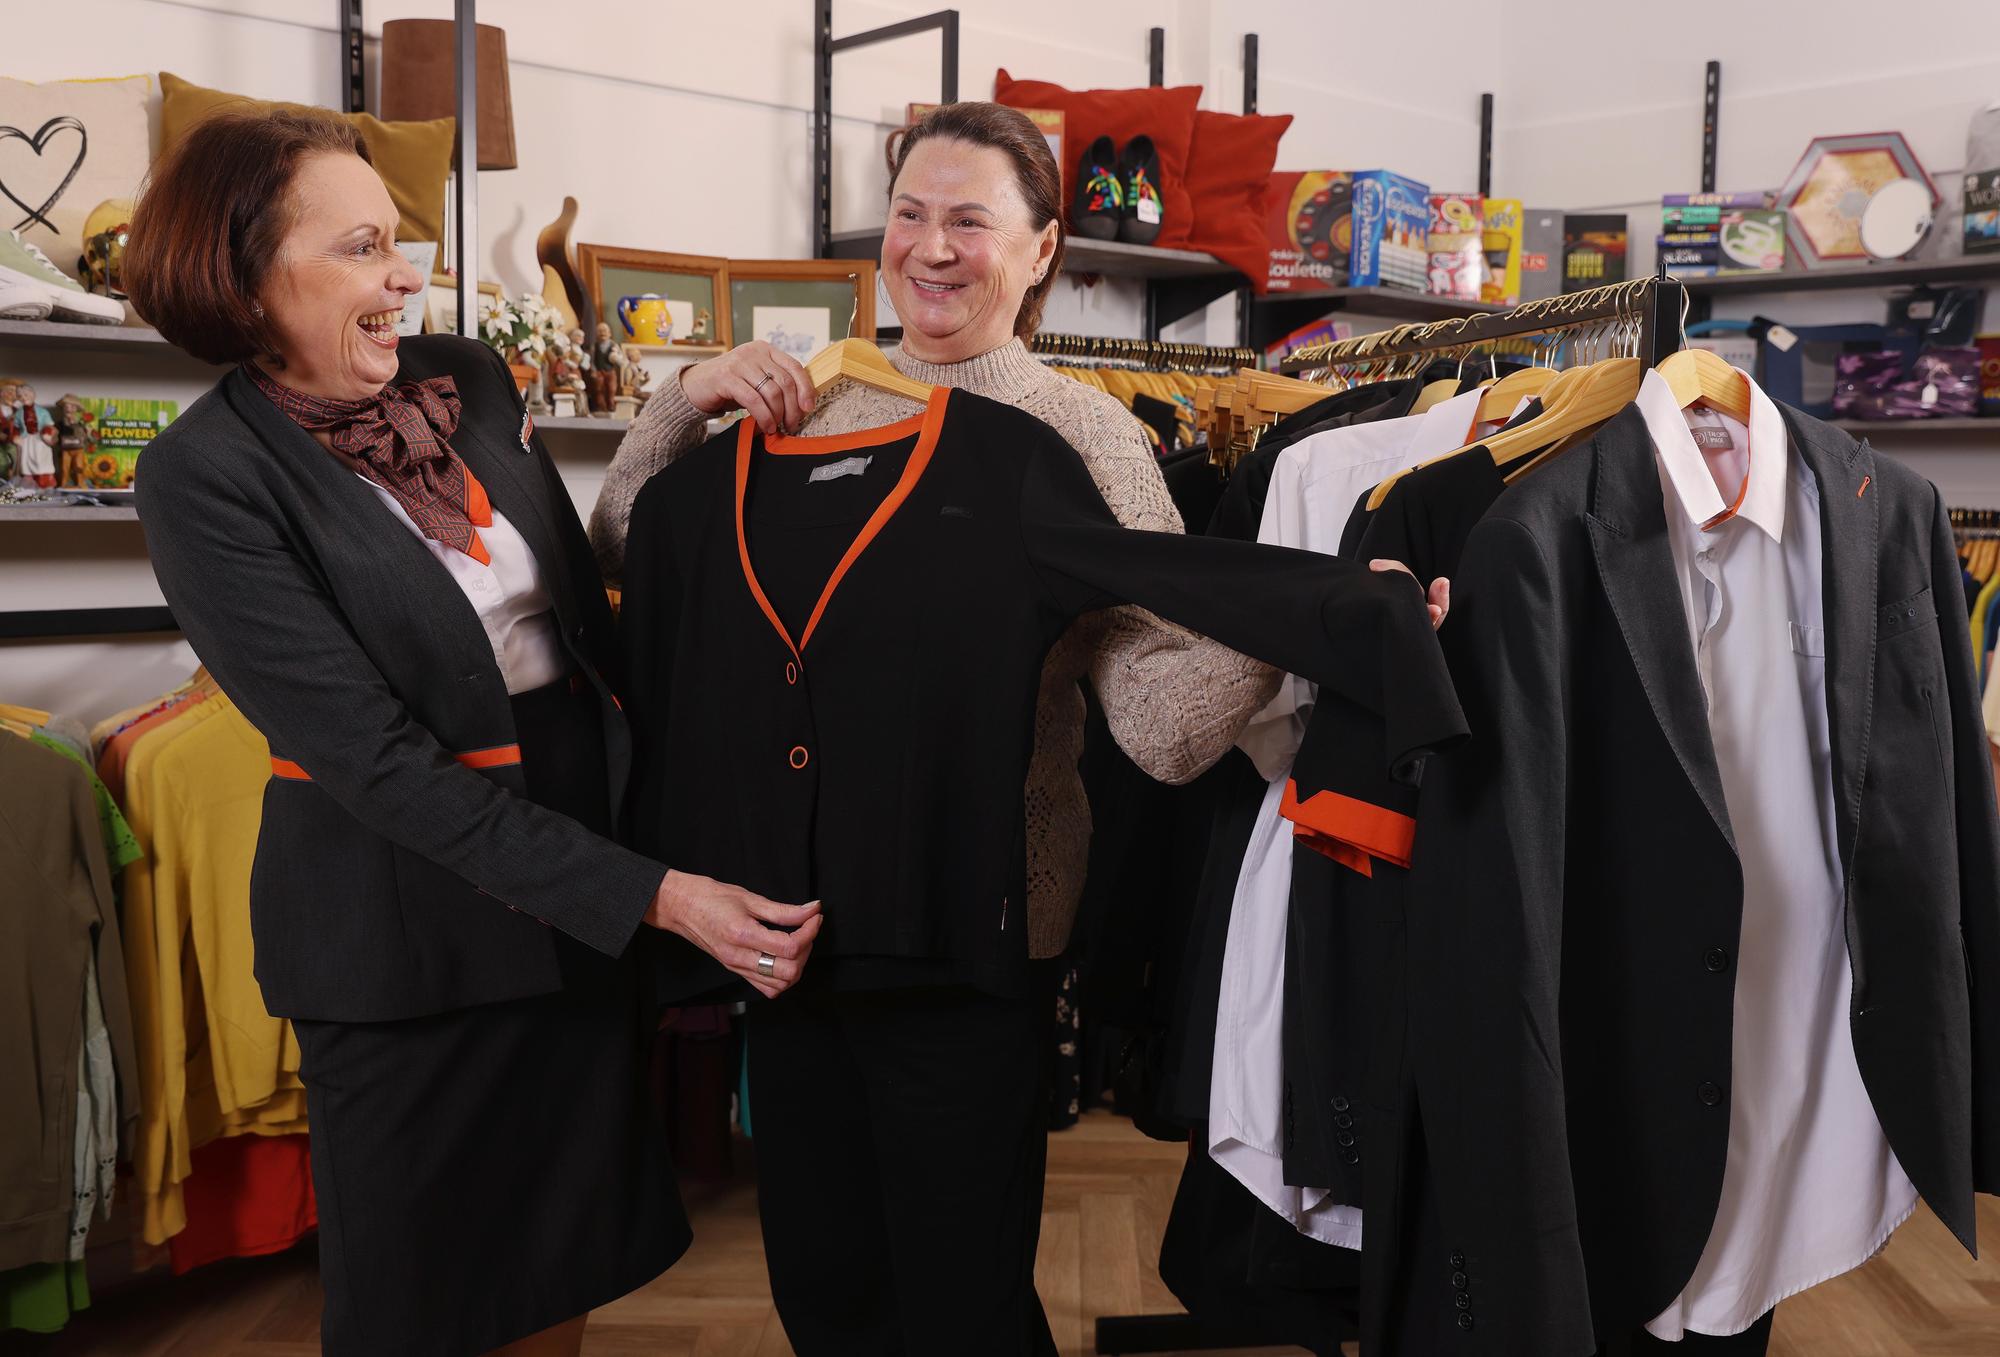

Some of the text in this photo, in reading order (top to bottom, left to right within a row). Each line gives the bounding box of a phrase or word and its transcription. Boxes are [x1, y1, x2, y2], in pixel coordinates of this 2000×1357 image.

[1270, 249, 1304, 264] rinking
[1269, 262, 1334, 279] oulette
[1267, 280, 1290, 289] ame
[105, 420, 123, 428] WHO
[101, 428, 158, 439] FLOWERS
